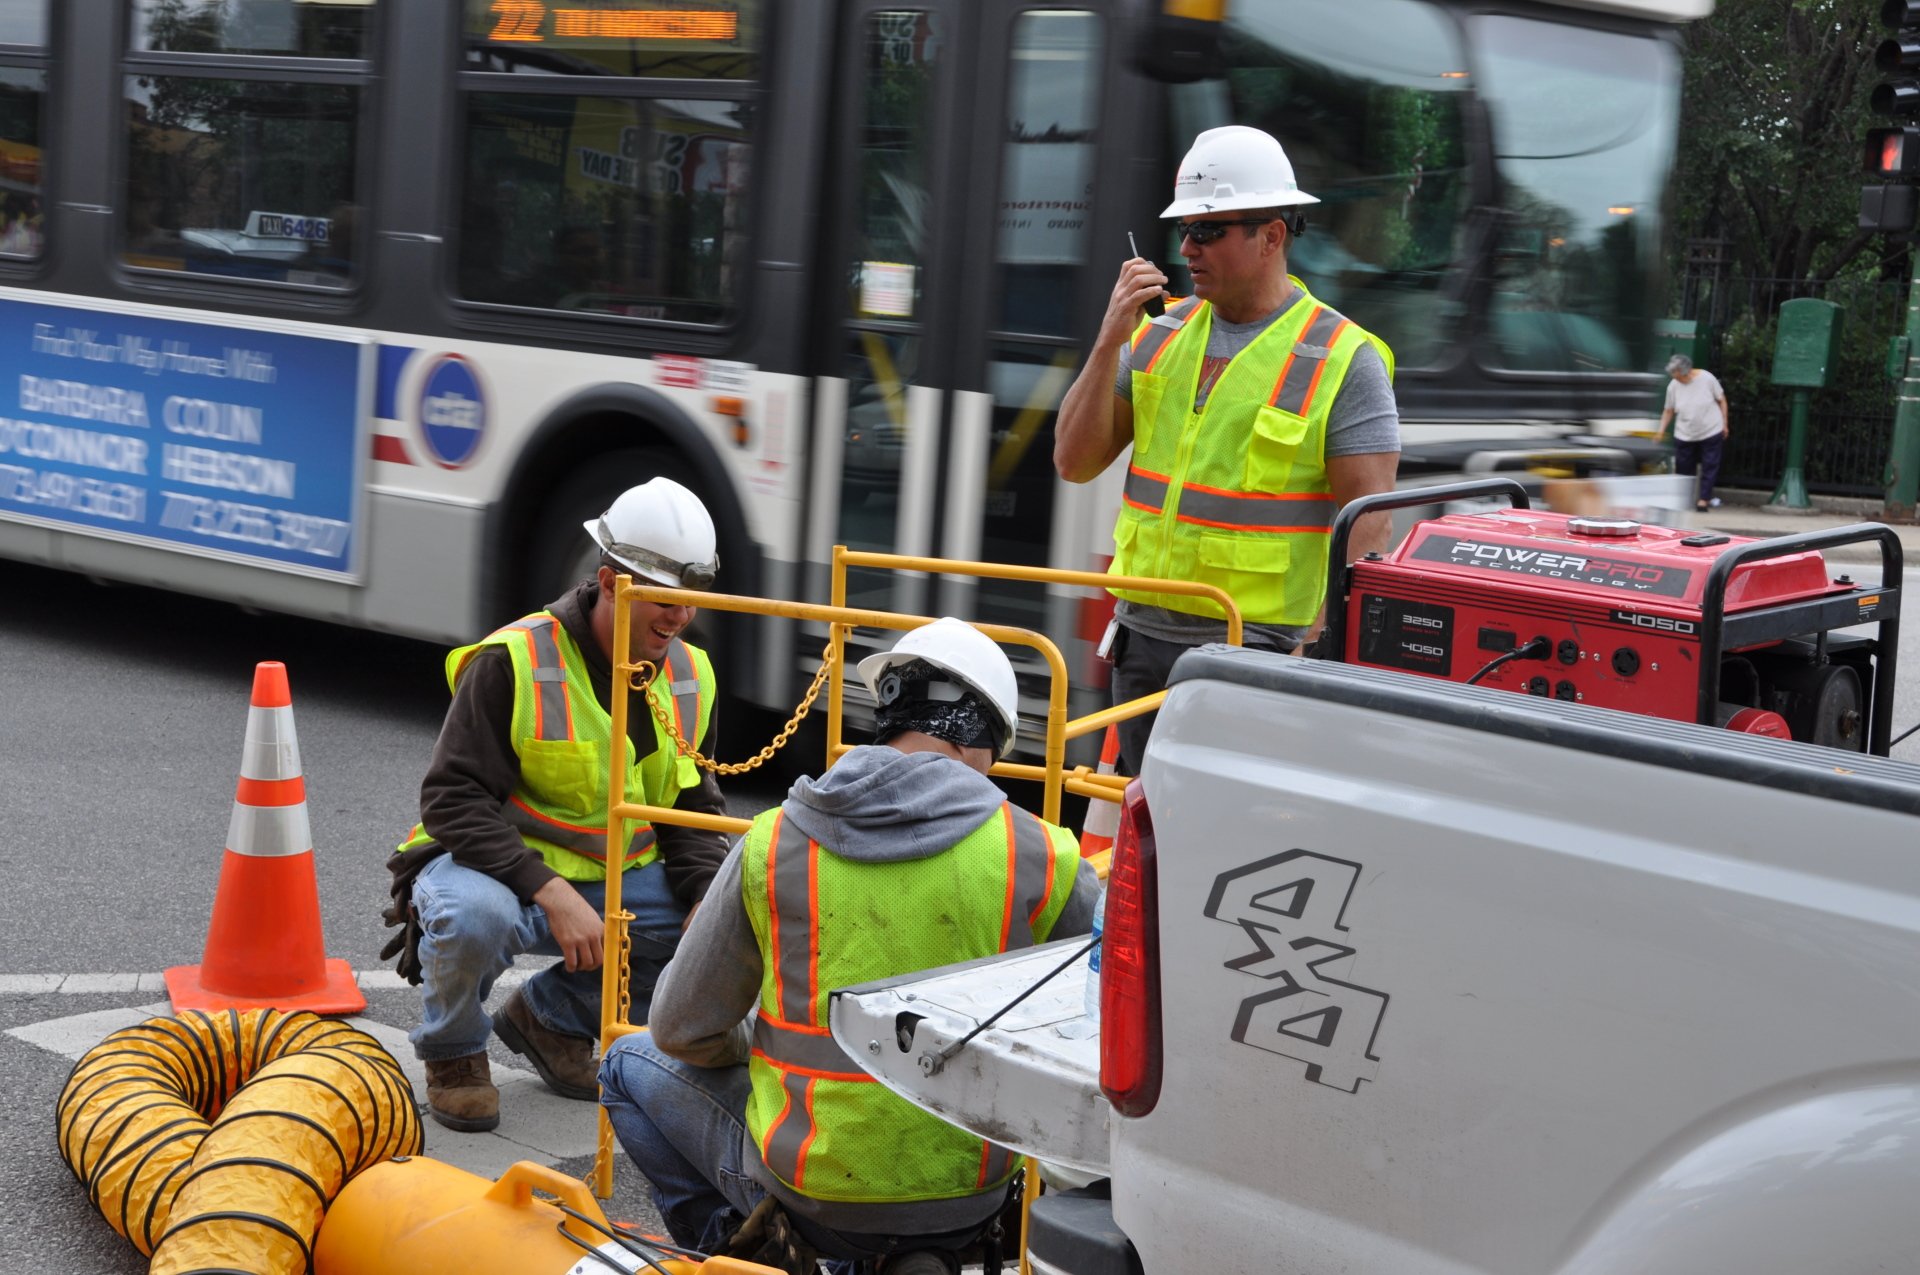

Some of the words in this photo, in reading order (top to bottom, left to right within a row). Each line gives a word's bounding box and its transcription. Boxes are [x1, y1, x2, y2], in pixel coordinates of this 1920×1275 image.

[487, 0, 546, 41] 22
[261, 216, 282, 235] TAXI
[282, 217, 327, 240] 6426
[20, 374, 150, 428] BARBARA
[1450, 556, 1653, 590] TECHNOLOGY
[1402, 614, 1443, 629] 3250
[1617, 611, 1695, 635] 4050
[1401, 641, 1444, 657] 4050
